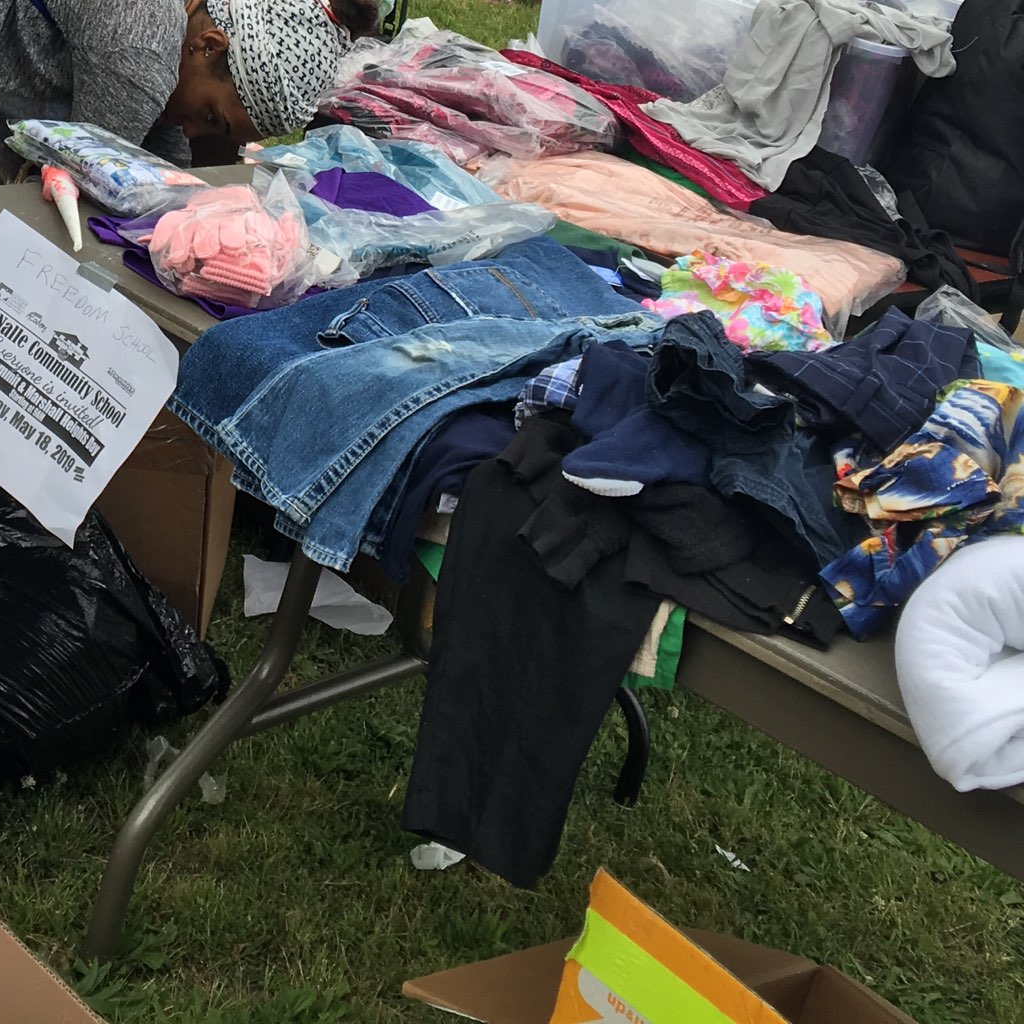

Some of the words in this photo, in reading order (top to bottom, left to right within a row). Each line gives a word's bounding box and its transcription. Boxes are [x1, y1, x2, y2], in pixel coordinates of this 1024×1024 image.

[16, 248, 109, 323] FREEDOM
[113, 326, 155, 363] SCHOOL
[25, 403, 35, 413] at
[27, 340, 93, 400] Community
[90, 390, 126, 428] School
[41, 381, 52, 393] is
[55, 391, 104, 429] invited!
[8, 410, 36, 440] May
[34, 431, 52, 453] 18,
[49, 444, 76, 472] 2019
[16, 381, 27, 393] &
[23, 384, 63, 422] Marshall
[58, 413, 90, 444] Heights
[84, 435, 100, 456] Day
